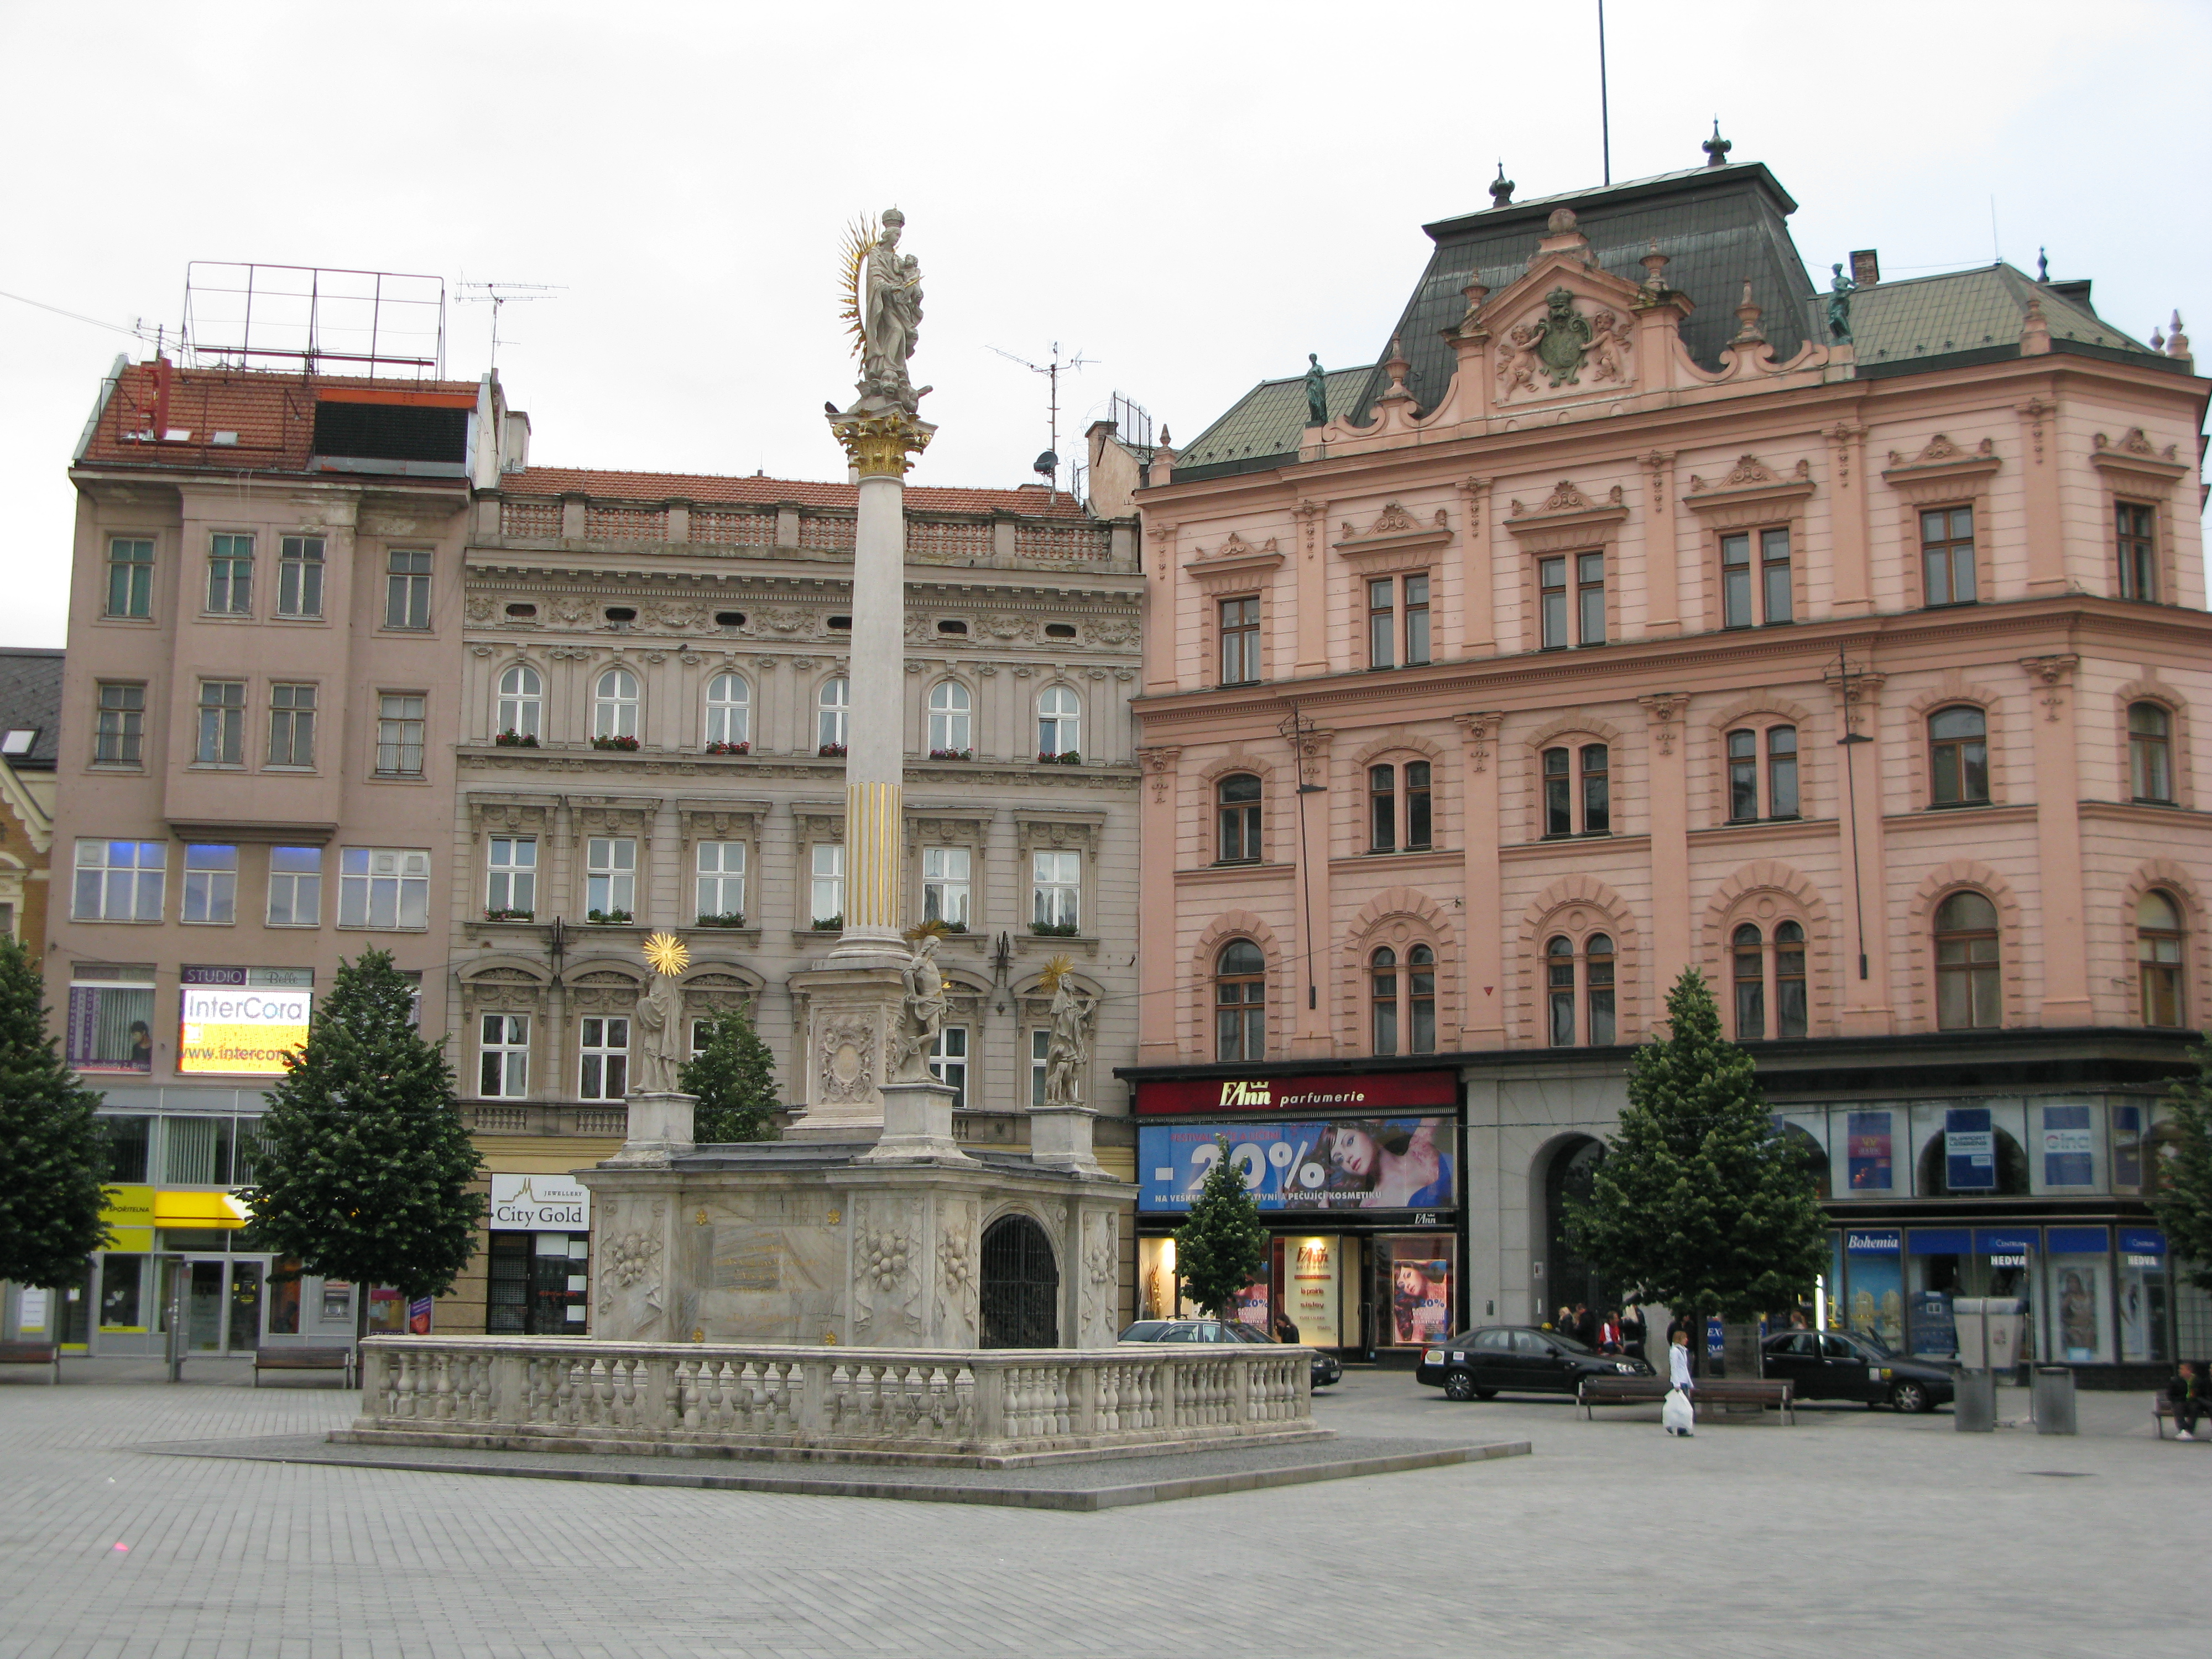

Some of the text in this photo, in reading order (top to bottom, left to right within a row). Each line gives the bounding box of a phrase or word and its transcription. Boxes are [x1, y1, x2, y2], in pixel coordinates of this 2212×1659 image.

[187, 969, 299, 984] STUDIO Belle
[189, 995, 302, 1020] InterCora
[84, 989, 94, 1049] KOSMETIKA
[90, 1061, 121, 1071] Svobody
[1219, 1081, 1365, 1108] FAnn parfumerie
[1171, 1131, 1213, 1142] FESTIVAL
[1240, 1132, 1246, 1140] A
[1188, 1140, 1326, 1190] 20%
[1155, 1194, 1168, 1203] NA
[1288, 1190, 1326, 1201] PEČUJÍCÍ
[1329, 1191, 1382, 1200] KOSMETIKU
[497, 1206, 582, 1227] City Gold
[1415, 1213, 1436, 1224] FAnn
[1848, 1235, 1899, 1249] Bohemia
[1991, 1255, 2026, 1266] HEDVA
[2128, 1256, 2158, 1265] HEDVA
[1306, 1287, 1324, 1296] prairie
[1245, 1299, 1268, 1307] 20%
[1419, 1298, 1445, 1308] 20%
